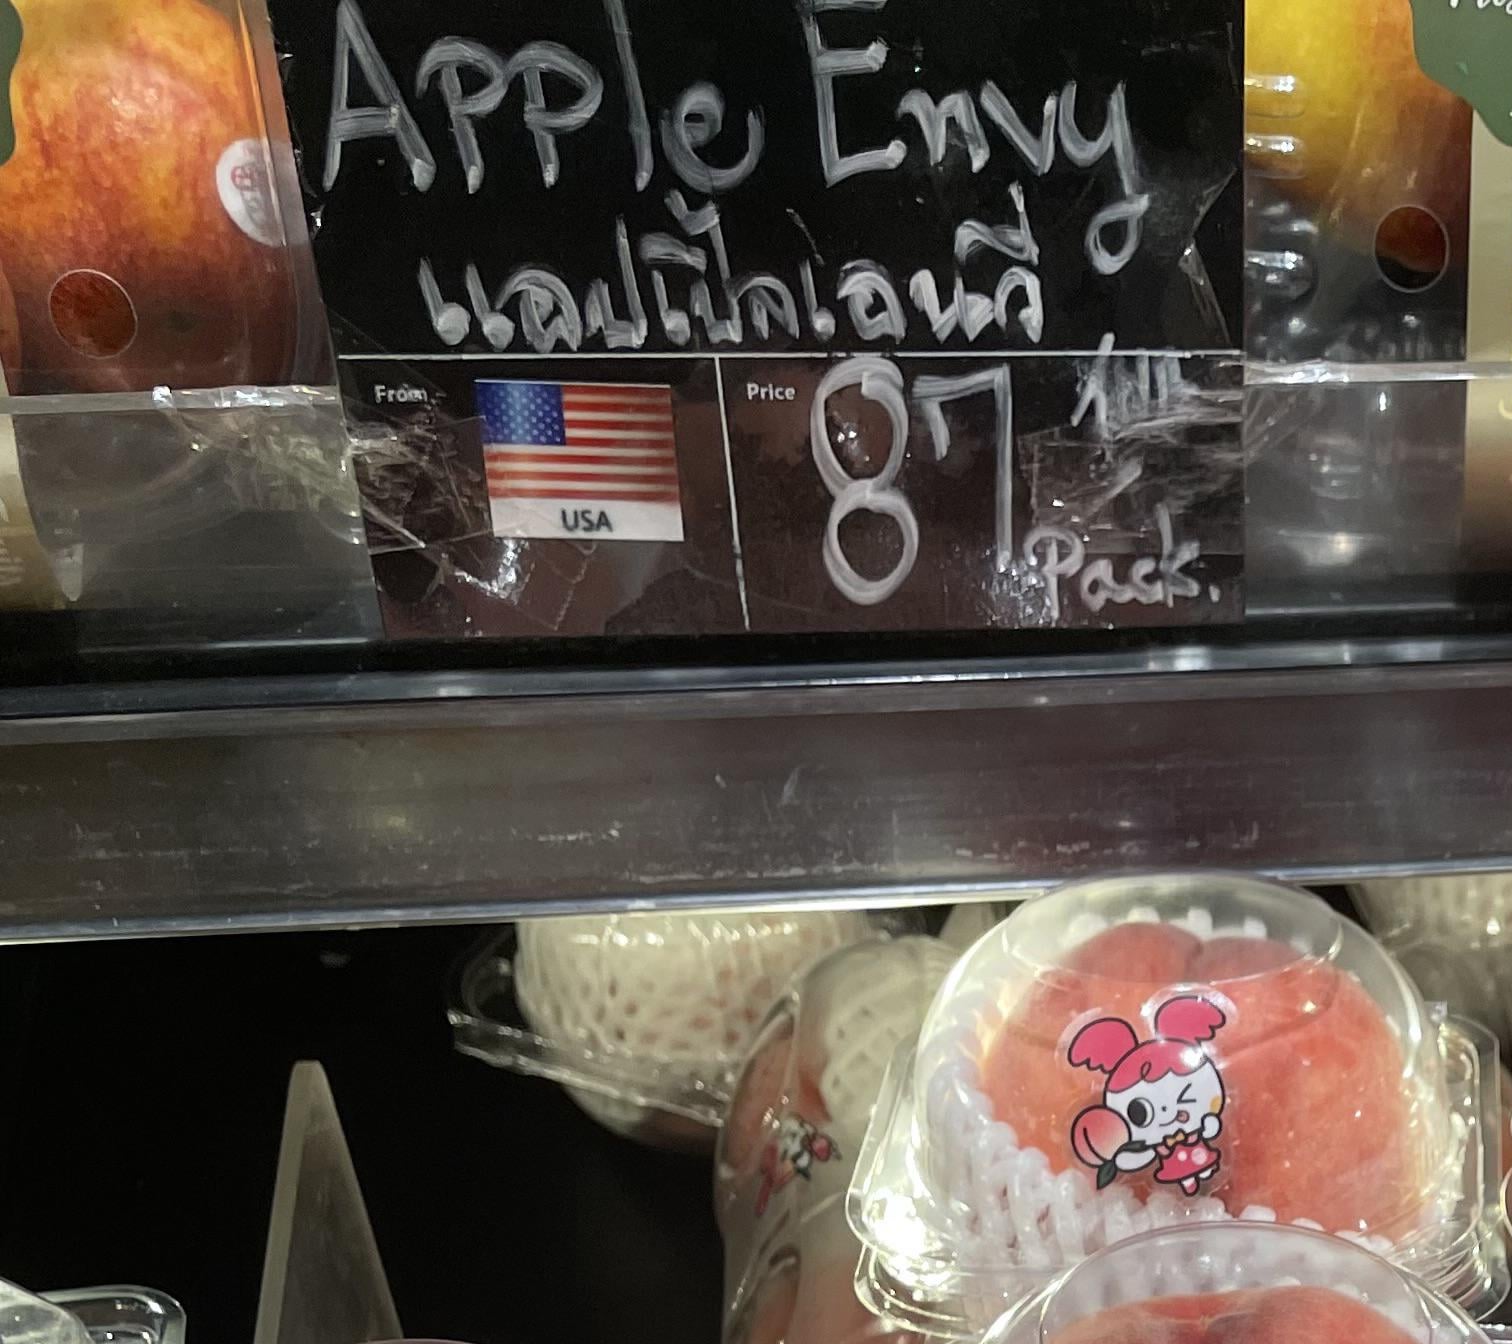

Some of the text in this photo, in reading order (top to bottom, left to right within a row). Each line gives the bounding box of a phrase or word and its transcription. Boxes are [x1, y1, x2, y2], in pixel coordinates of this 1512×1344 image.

[803, 0, 1149, 275] Envy
[374, 382, 796, 403] From Price
[560, 508, 613, 533] USA
[809, 354, 1013, 604] 87
